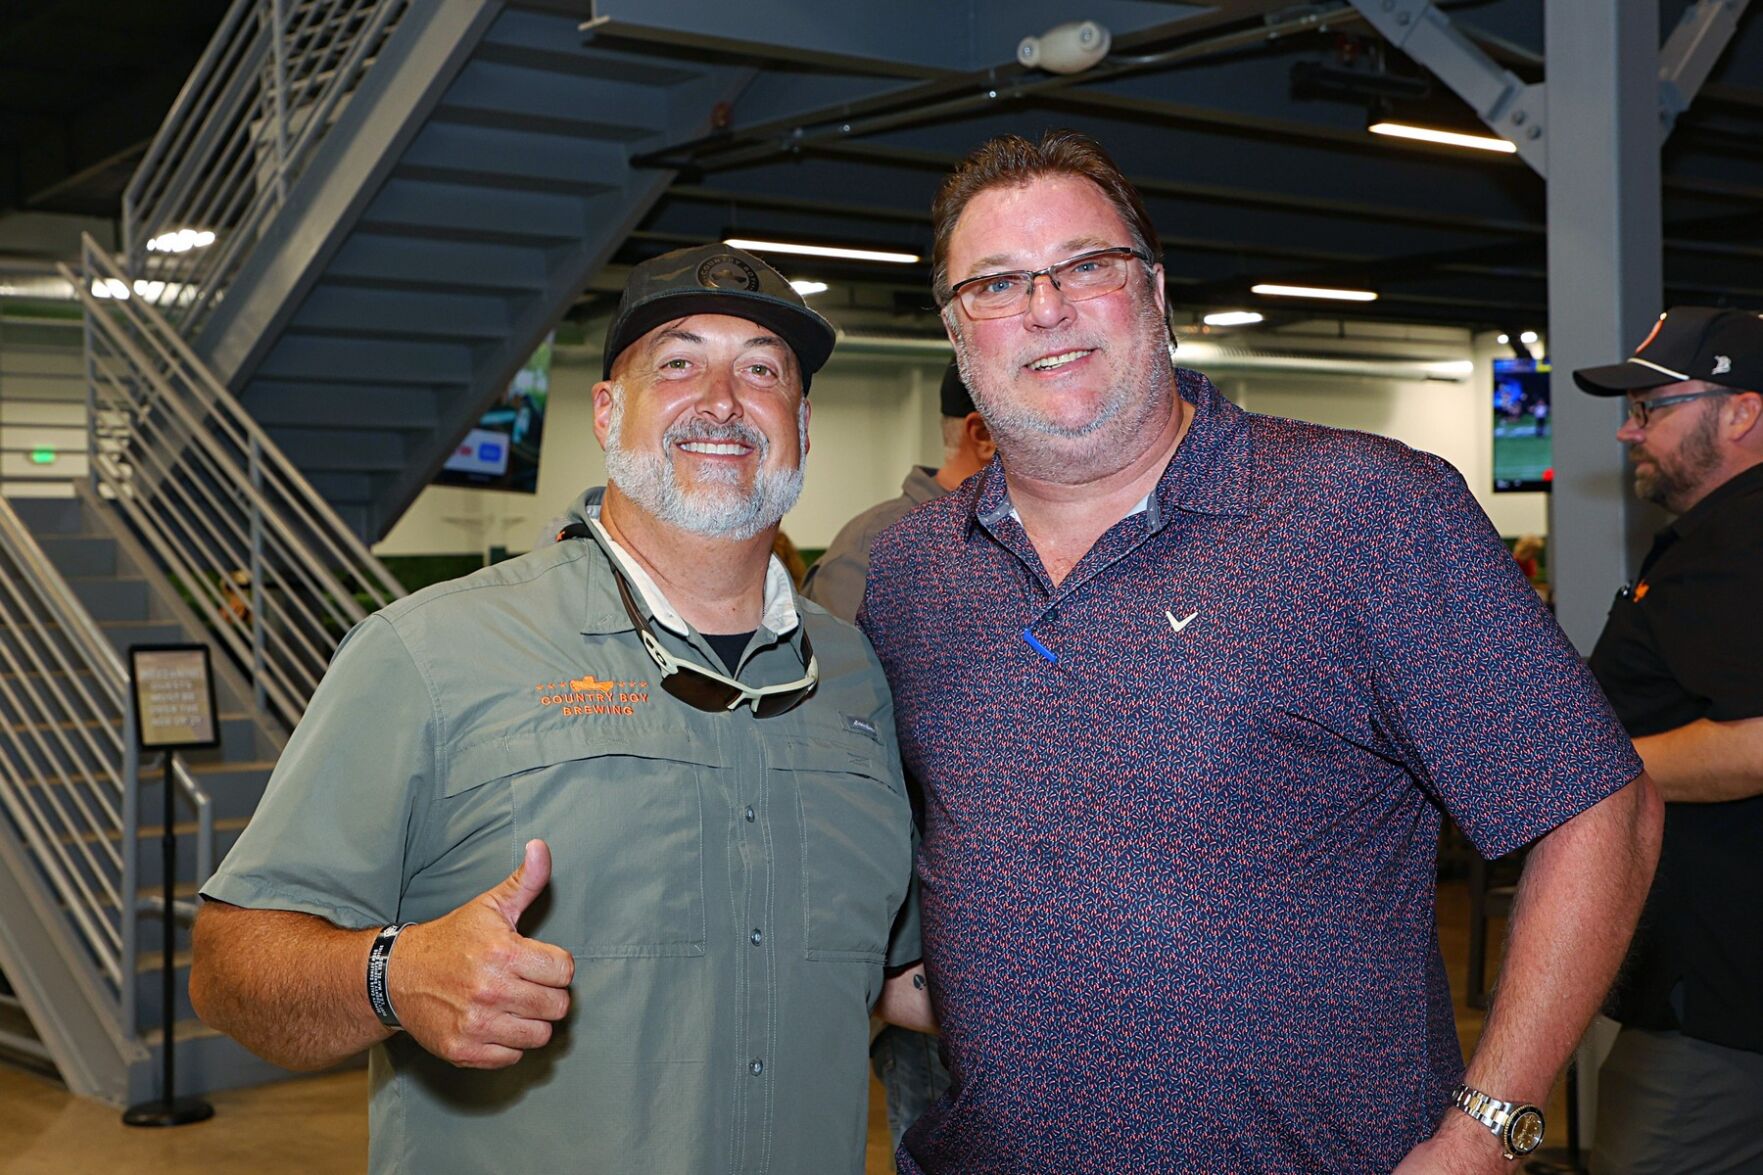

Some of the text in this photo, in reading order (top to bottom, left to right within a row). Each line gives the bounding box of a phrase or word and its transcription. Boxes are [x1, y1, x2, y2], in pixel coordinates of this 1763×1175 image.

[541, 692, 649, 705] COUNTRY BOY
[562, 705, 634, 717] BREWING
